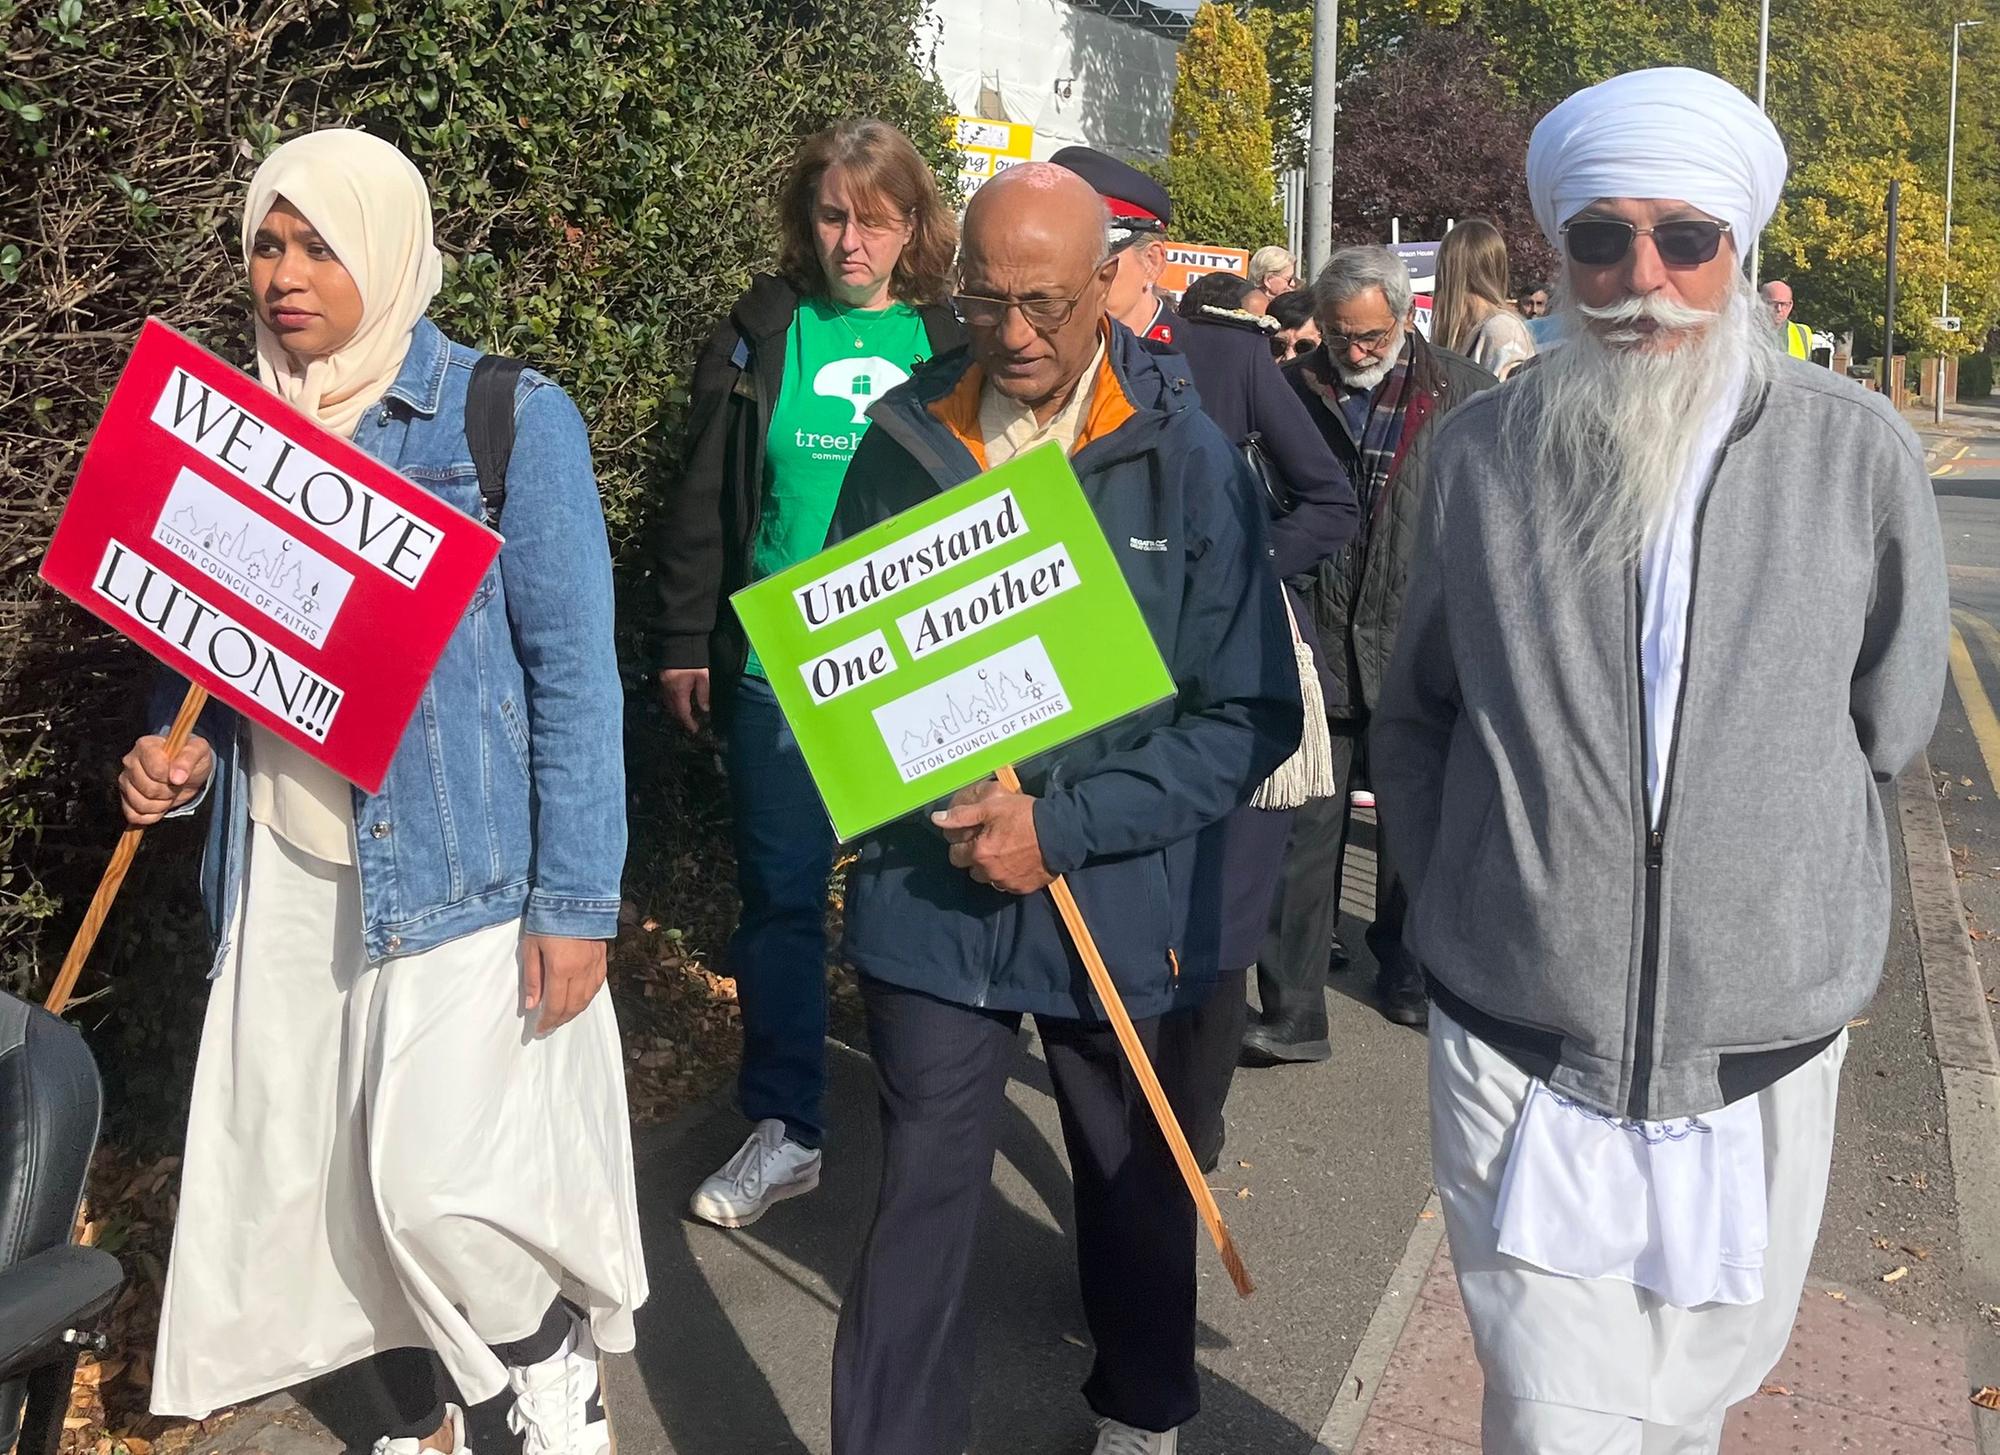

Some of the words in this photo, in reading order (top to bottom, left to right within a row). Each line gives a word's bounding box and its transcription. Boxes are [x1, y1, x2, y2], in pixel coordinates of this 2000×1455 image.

[1165, 250, 1239, 269] UNITY
[173, 371, 264, 473] WE
[261, 440, 436, 584] LOVE
[794, 427, 863, 451] treeh
[158, 529, 198, 561] LUTON
[200, 557, 251, 598] COUNCIL
[255, 594, 273, 609] OF
[274, 606, 318, 641] FAITHS
[799, 495, 1020, 626] Understand
[97, 547, 341, 737] LUTON!!!
[811, 645, 888, 699] One
[914, 557, 1066, 653] Another
[905, 754, 945, 778] LUTON
[947, 730, 999, 760] COUNCIL
[1001, 720, 1017, 735] OF
[1020, 700, 1064, 726] FAITHS
